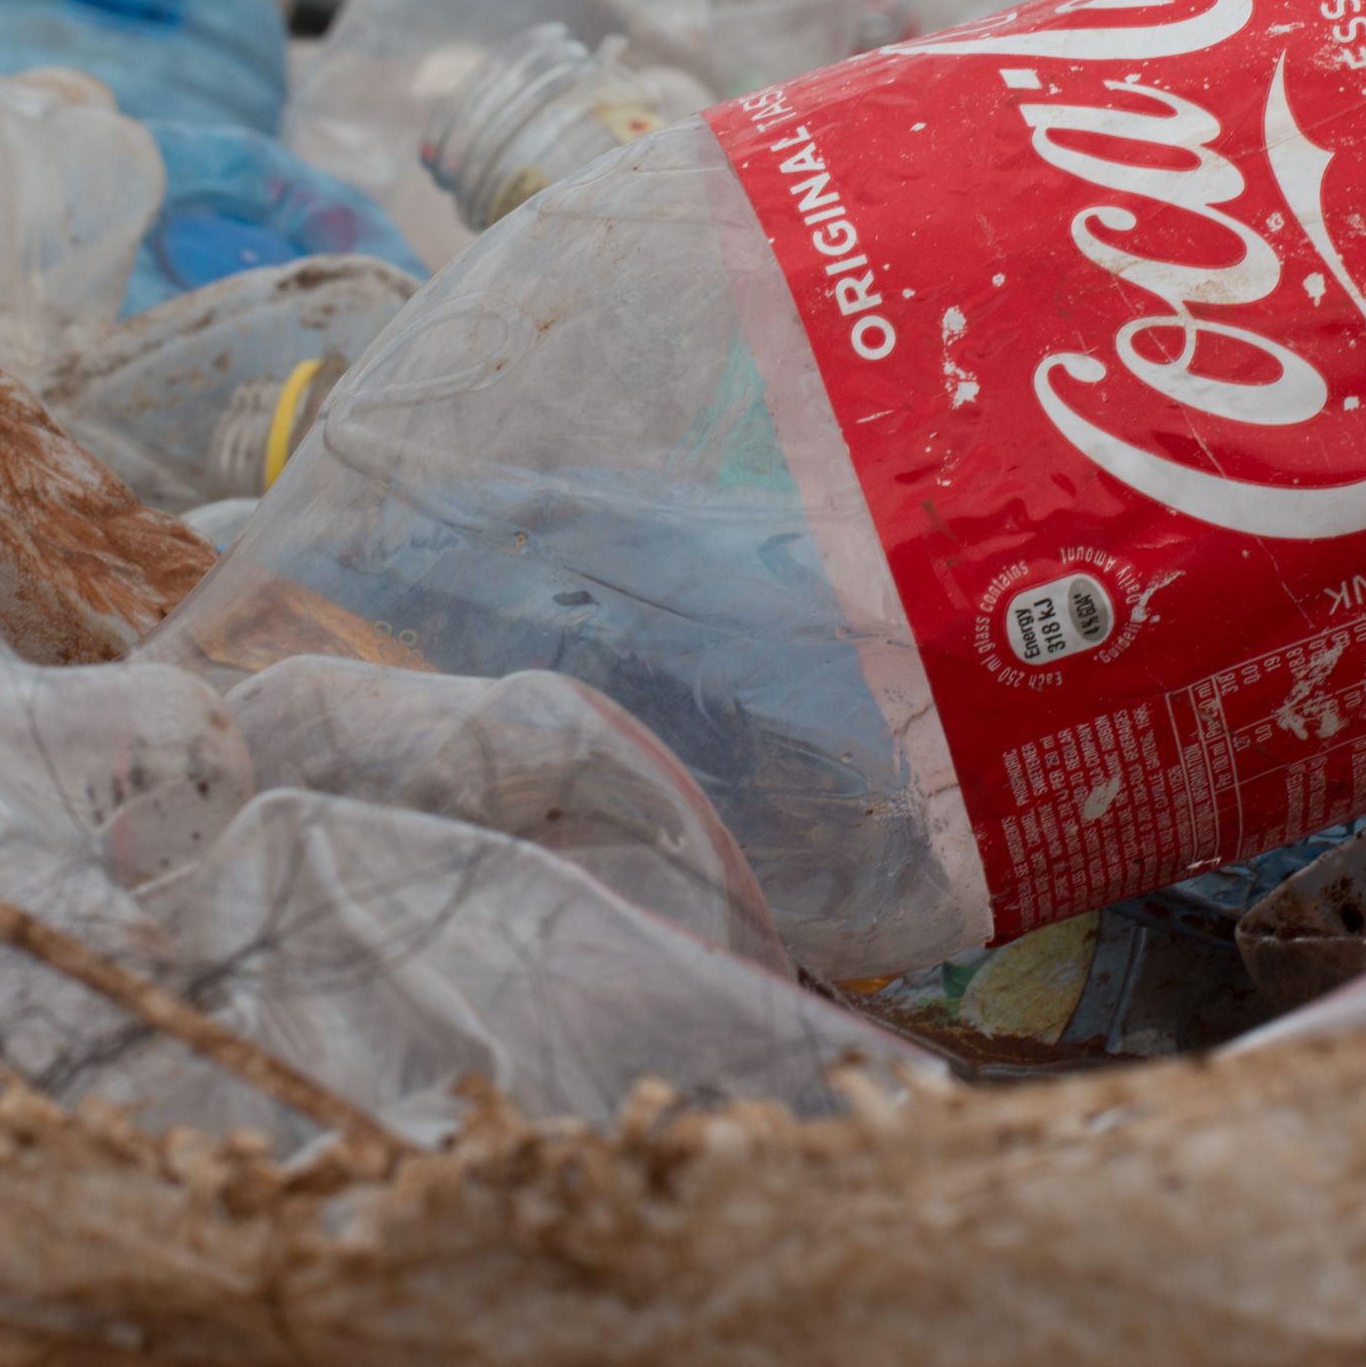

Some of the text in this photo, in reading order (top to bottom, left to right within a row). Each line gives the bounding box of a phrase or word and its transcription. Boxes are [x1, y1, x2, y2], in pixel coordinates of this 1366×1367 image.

[738, 86, 897, 362] ORIGINAL TAS
[1060, 546, 1116, 572] Amount
[975, 559, 1063, 691] Each 250 ml glass contains
[1016, 607, 1040, 660] Energy
[1042, 622, 1065, 653] 318
[1240, 663, 1262, 684] 0.0
[1262, 654, 1283, 673] 19
[1194, 681, 1212, 699] ml
[1038, 733, 1055, 750] ml
[1057, 727, 1081, 770] REGULAR
[1075, 721, 1100, 767] COMPANY
[1094, 714, 1116, 751] RIBBON
[1112, 708, 1139, 761] BEVERAGES
[1004, 748, 1030, 806] PHOSPHORIC
[1022, 741, 1047, 796] SWEETENER
[1042, 750, 1060, 768] 250
[1048, 767, 1066, 790] PER
[1183, 742, 1210, 802] INFORMATION
